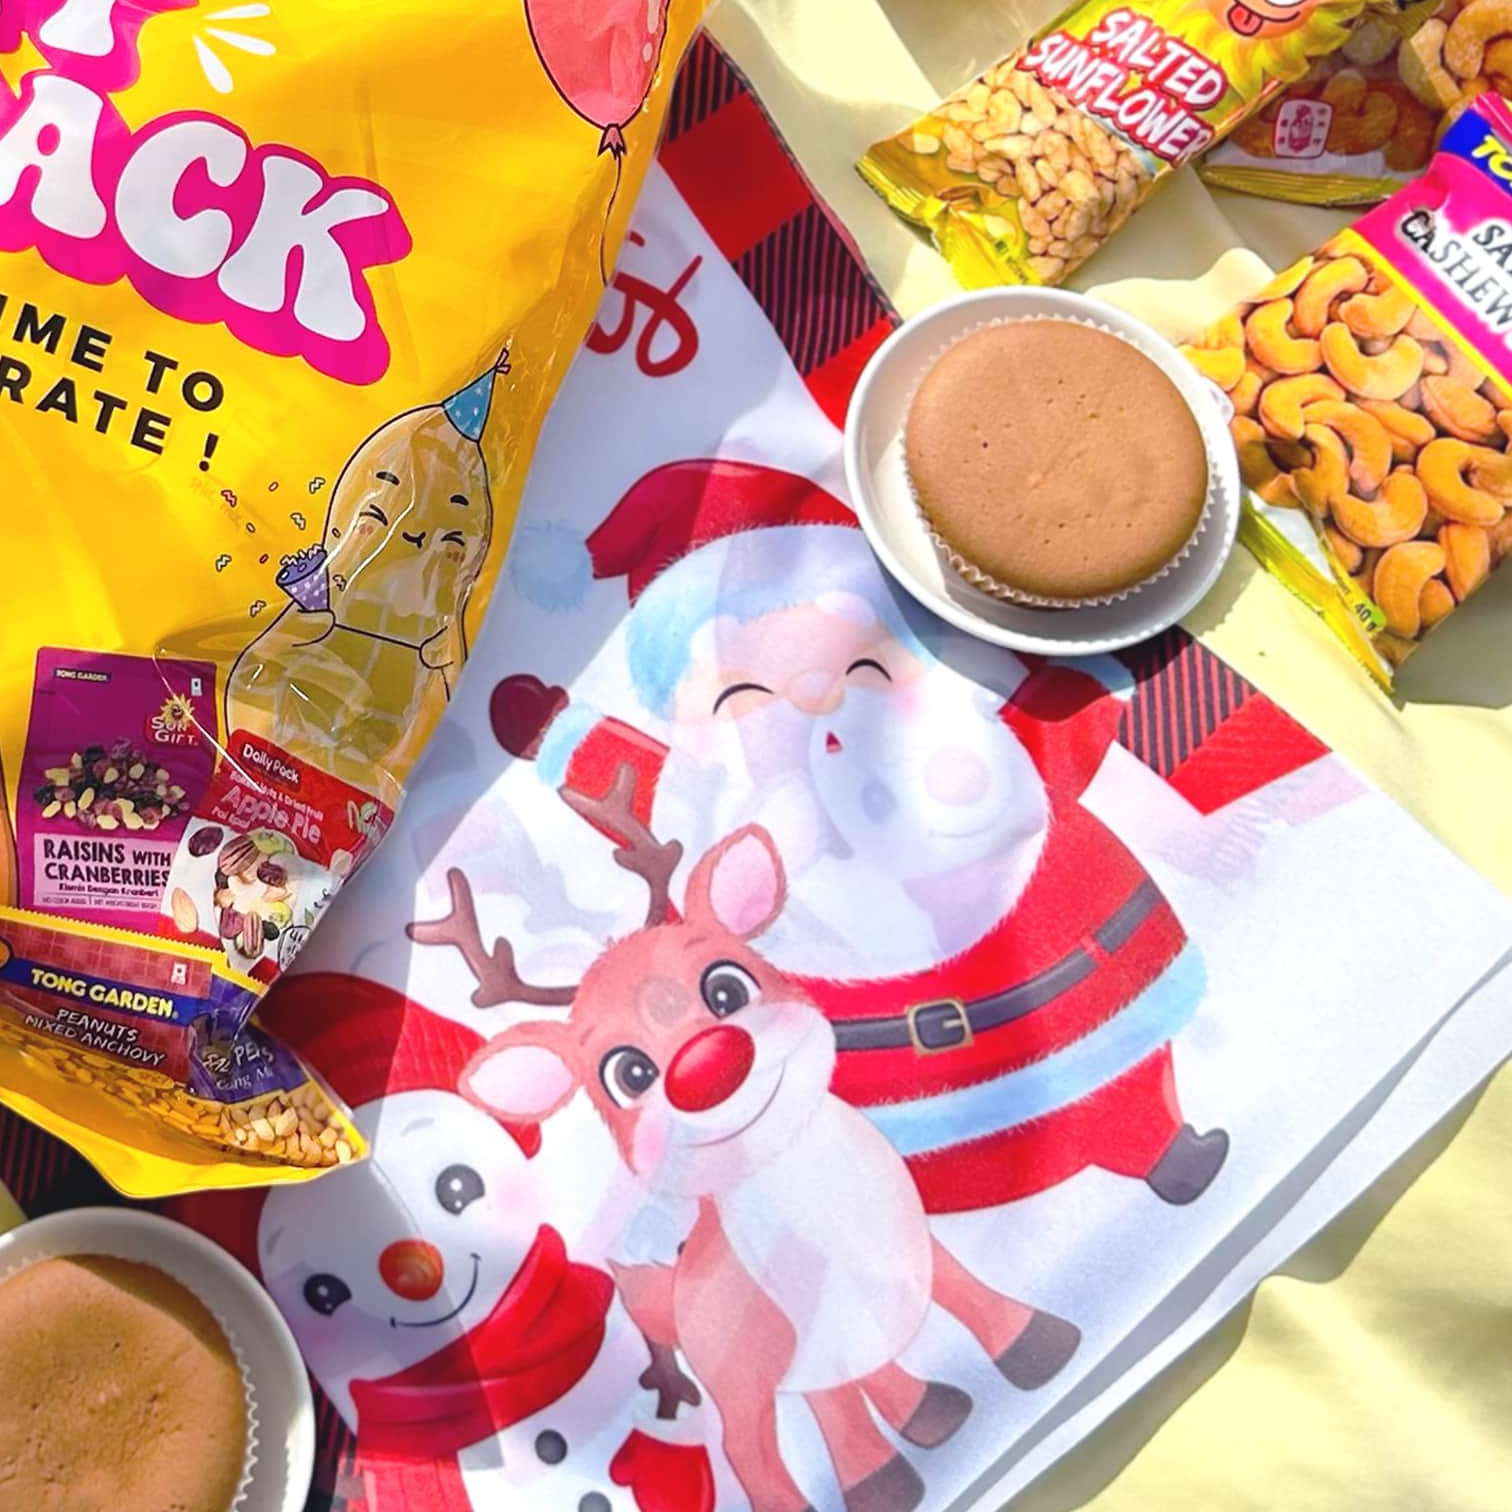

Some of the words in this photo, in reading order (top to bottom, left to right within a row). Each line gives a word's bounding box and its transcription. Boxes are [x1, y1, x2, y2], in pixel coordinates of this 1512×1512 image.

[1090, 10, 1223, 106] SALTED
[1025, 34, 1211, 161] SUNFLOWER
[142, 350, 225, 413] TO
[242, 743, 274, 771] Daily
[273, 759, 300, 785] Pack
[220, 785, 289, 828] Apple
[291, 812, 322, 844] Pie
[44, 838, 125, 865] RAISINS
[132, 849, 172, 867] WITH
[44, 862, 171, 888] CRANBERRIES
[31, 969, 87, 997] TONG
[88, 984, 174, 1017] GARDEN
[24, 1013, 77, 1039] MIXED
[80, 1032, 167, 1067] ANCHOVY
[56, 1008, 139, 1043] PEANUTS
